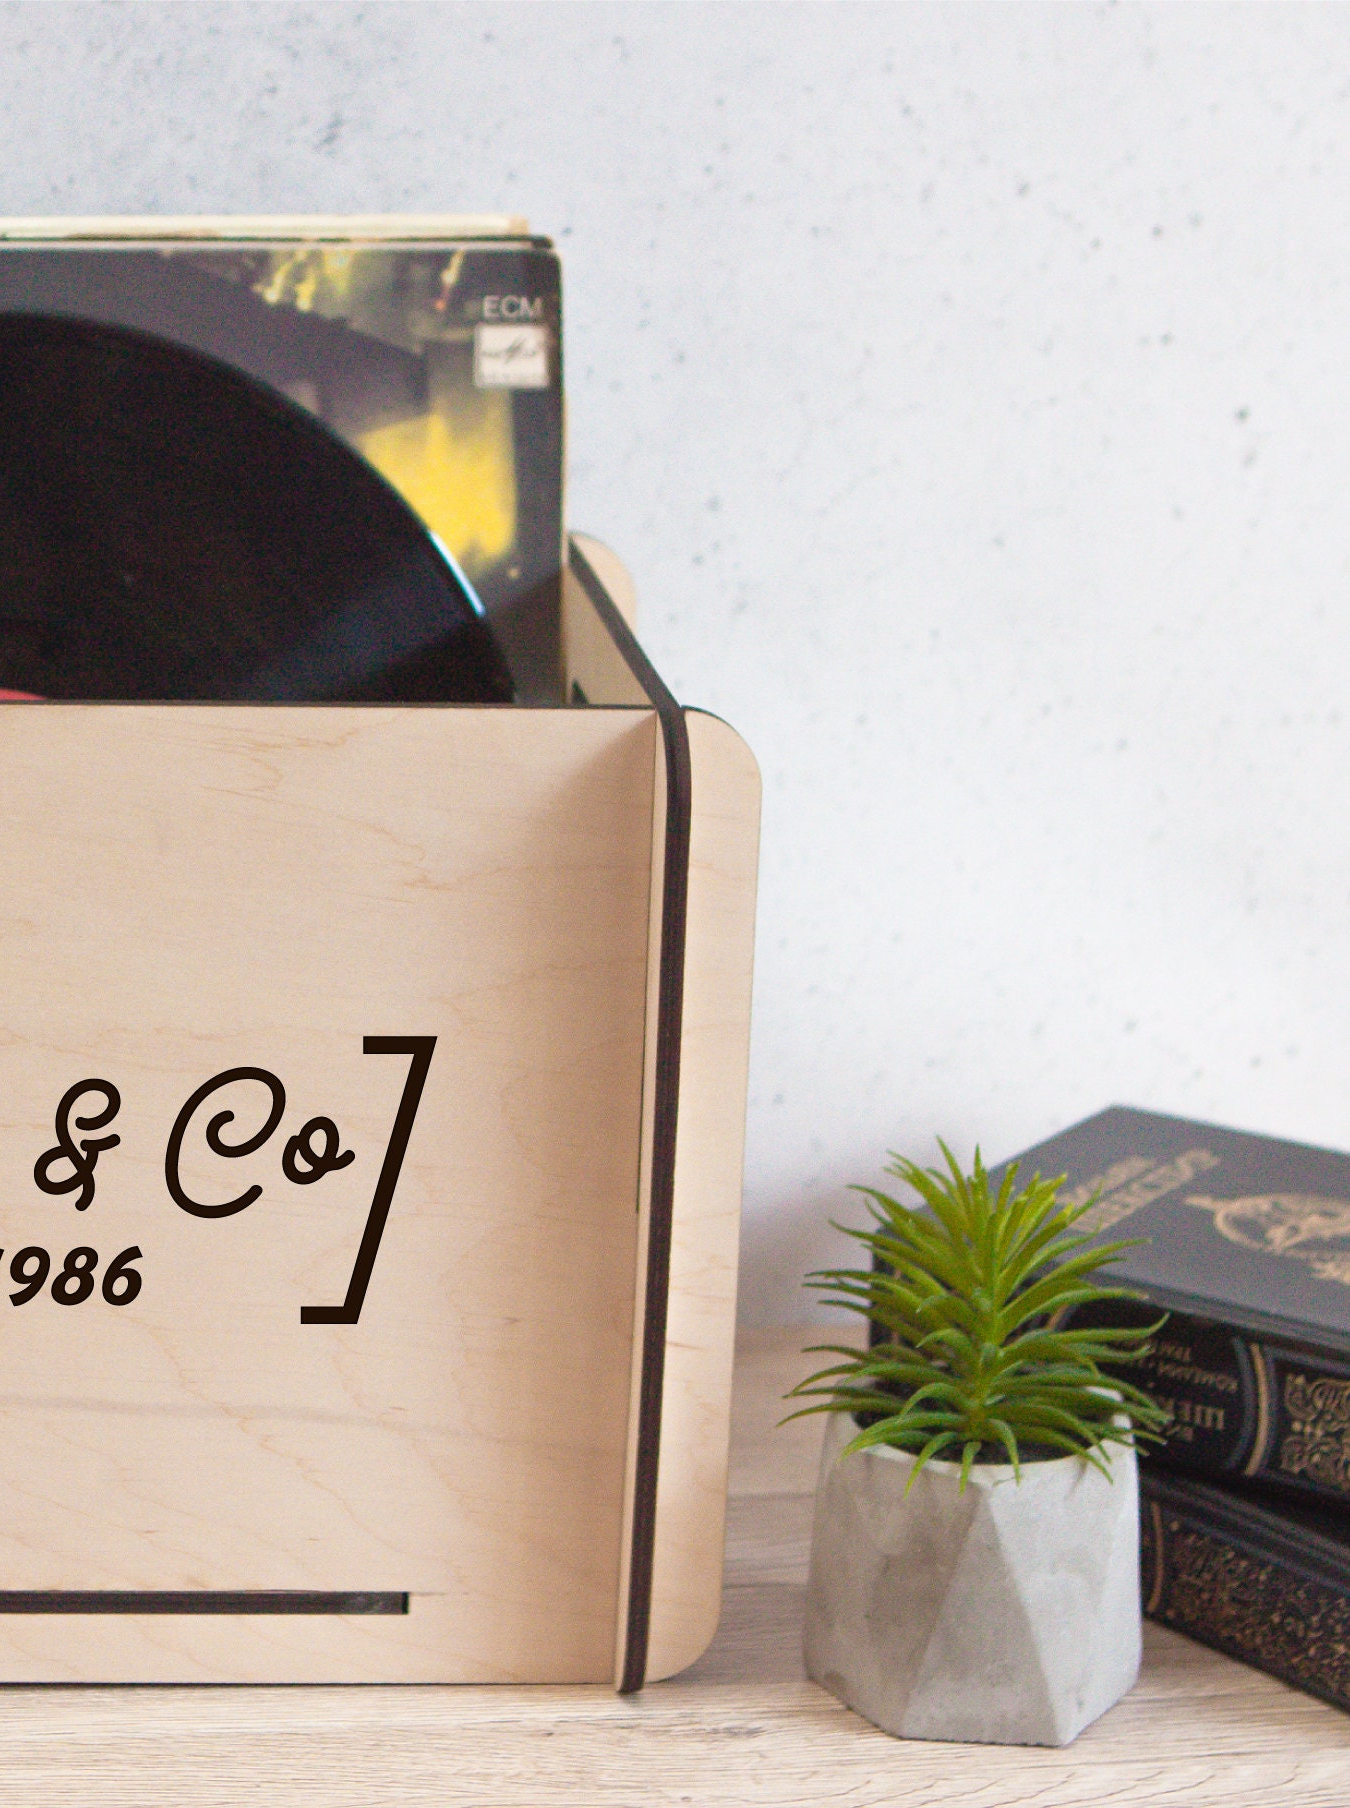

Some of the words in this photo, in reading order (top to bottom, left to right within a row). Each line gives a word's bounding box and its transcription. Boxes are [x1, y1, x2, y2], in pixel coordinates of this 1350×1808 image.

[482, 294, 543, 318] ECM
[33, 1078, 121, 1212] &
[164, 1066, 356, 1219] Co
